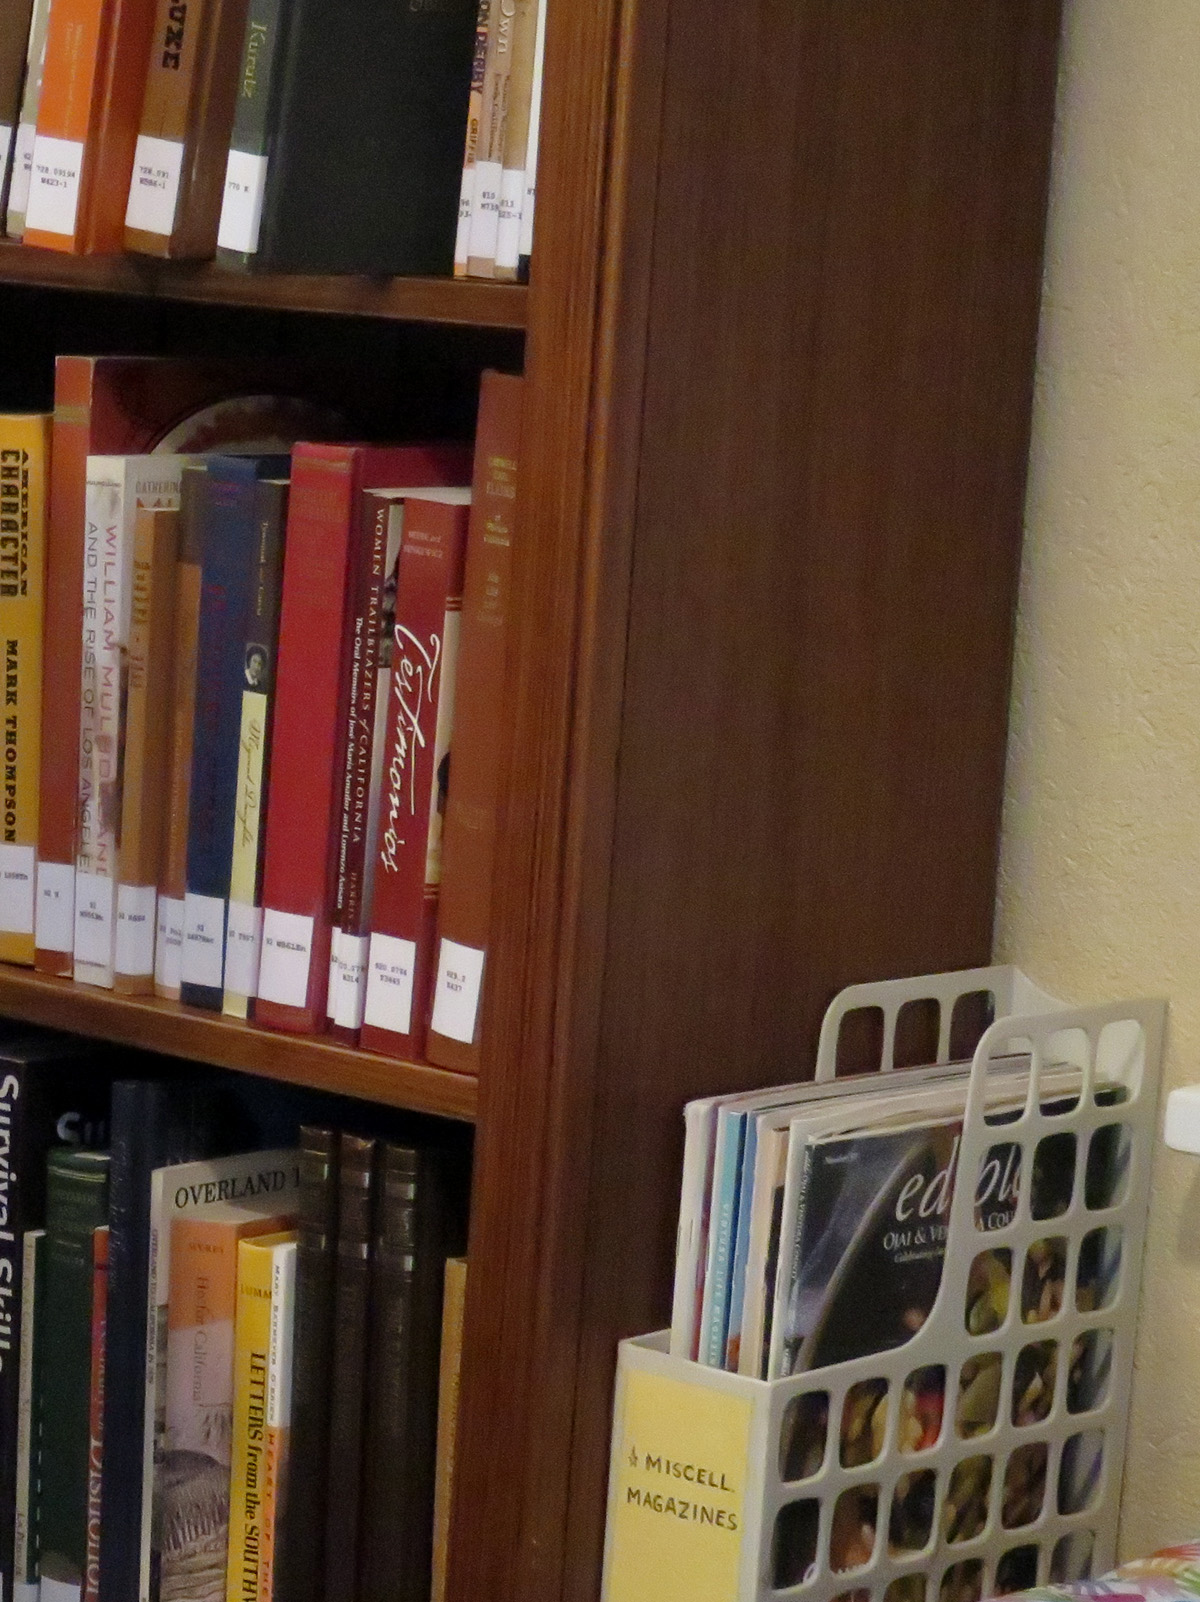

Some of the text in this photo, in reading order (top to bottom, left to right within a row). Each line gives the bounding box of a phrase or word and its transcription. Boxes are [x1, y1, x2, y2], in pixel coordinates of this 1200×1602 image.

[162, 0, 186, 70] UXE
[0, 449, 20, 597] CHARACTER
[21, 448, 29, 597] AMERICAN
[87, 522, 98, 568] AND
[372, 509, 385, 576] WOMEN
[86, 578, 97, 619] THE
[103, 526, 118, 651] WILLIAM
[354, 637, 362, 659] Oral
[355, 617, 363, 634] The
[84, 629, 97, 682] RISE
[361, 586, 379, 711] TRAILBLAZERS
[83, 689, 94, 716] OF
[350, 661, 360, 704] Memoirs
[349, 707, 358, 717] of
[4, 639, 19, 842] MARK THOMPSON
[82, 728, 93, 769] LOS
[380, 624, 441, 873] Testimonios
[343, 772, 353, 811] Amador
[352, 735, 368, 843] CALIFORNIA
[342, 813, 350, 831] and
[339, 834, 348, 873] Lorenzo
[175, 1169, 287, 1209] OVERLAND
[709, 1305, 721, 1365] MAGAZIN
[248, 1353, 266, 1441] LETTERS
[246, 1444, 262, 1489] from
[245, 1492, 261, 1520] the
[262, 1434, 275, 1597] HEART OF THE
[627, 1486, 738, 1531] MAGAZINES
